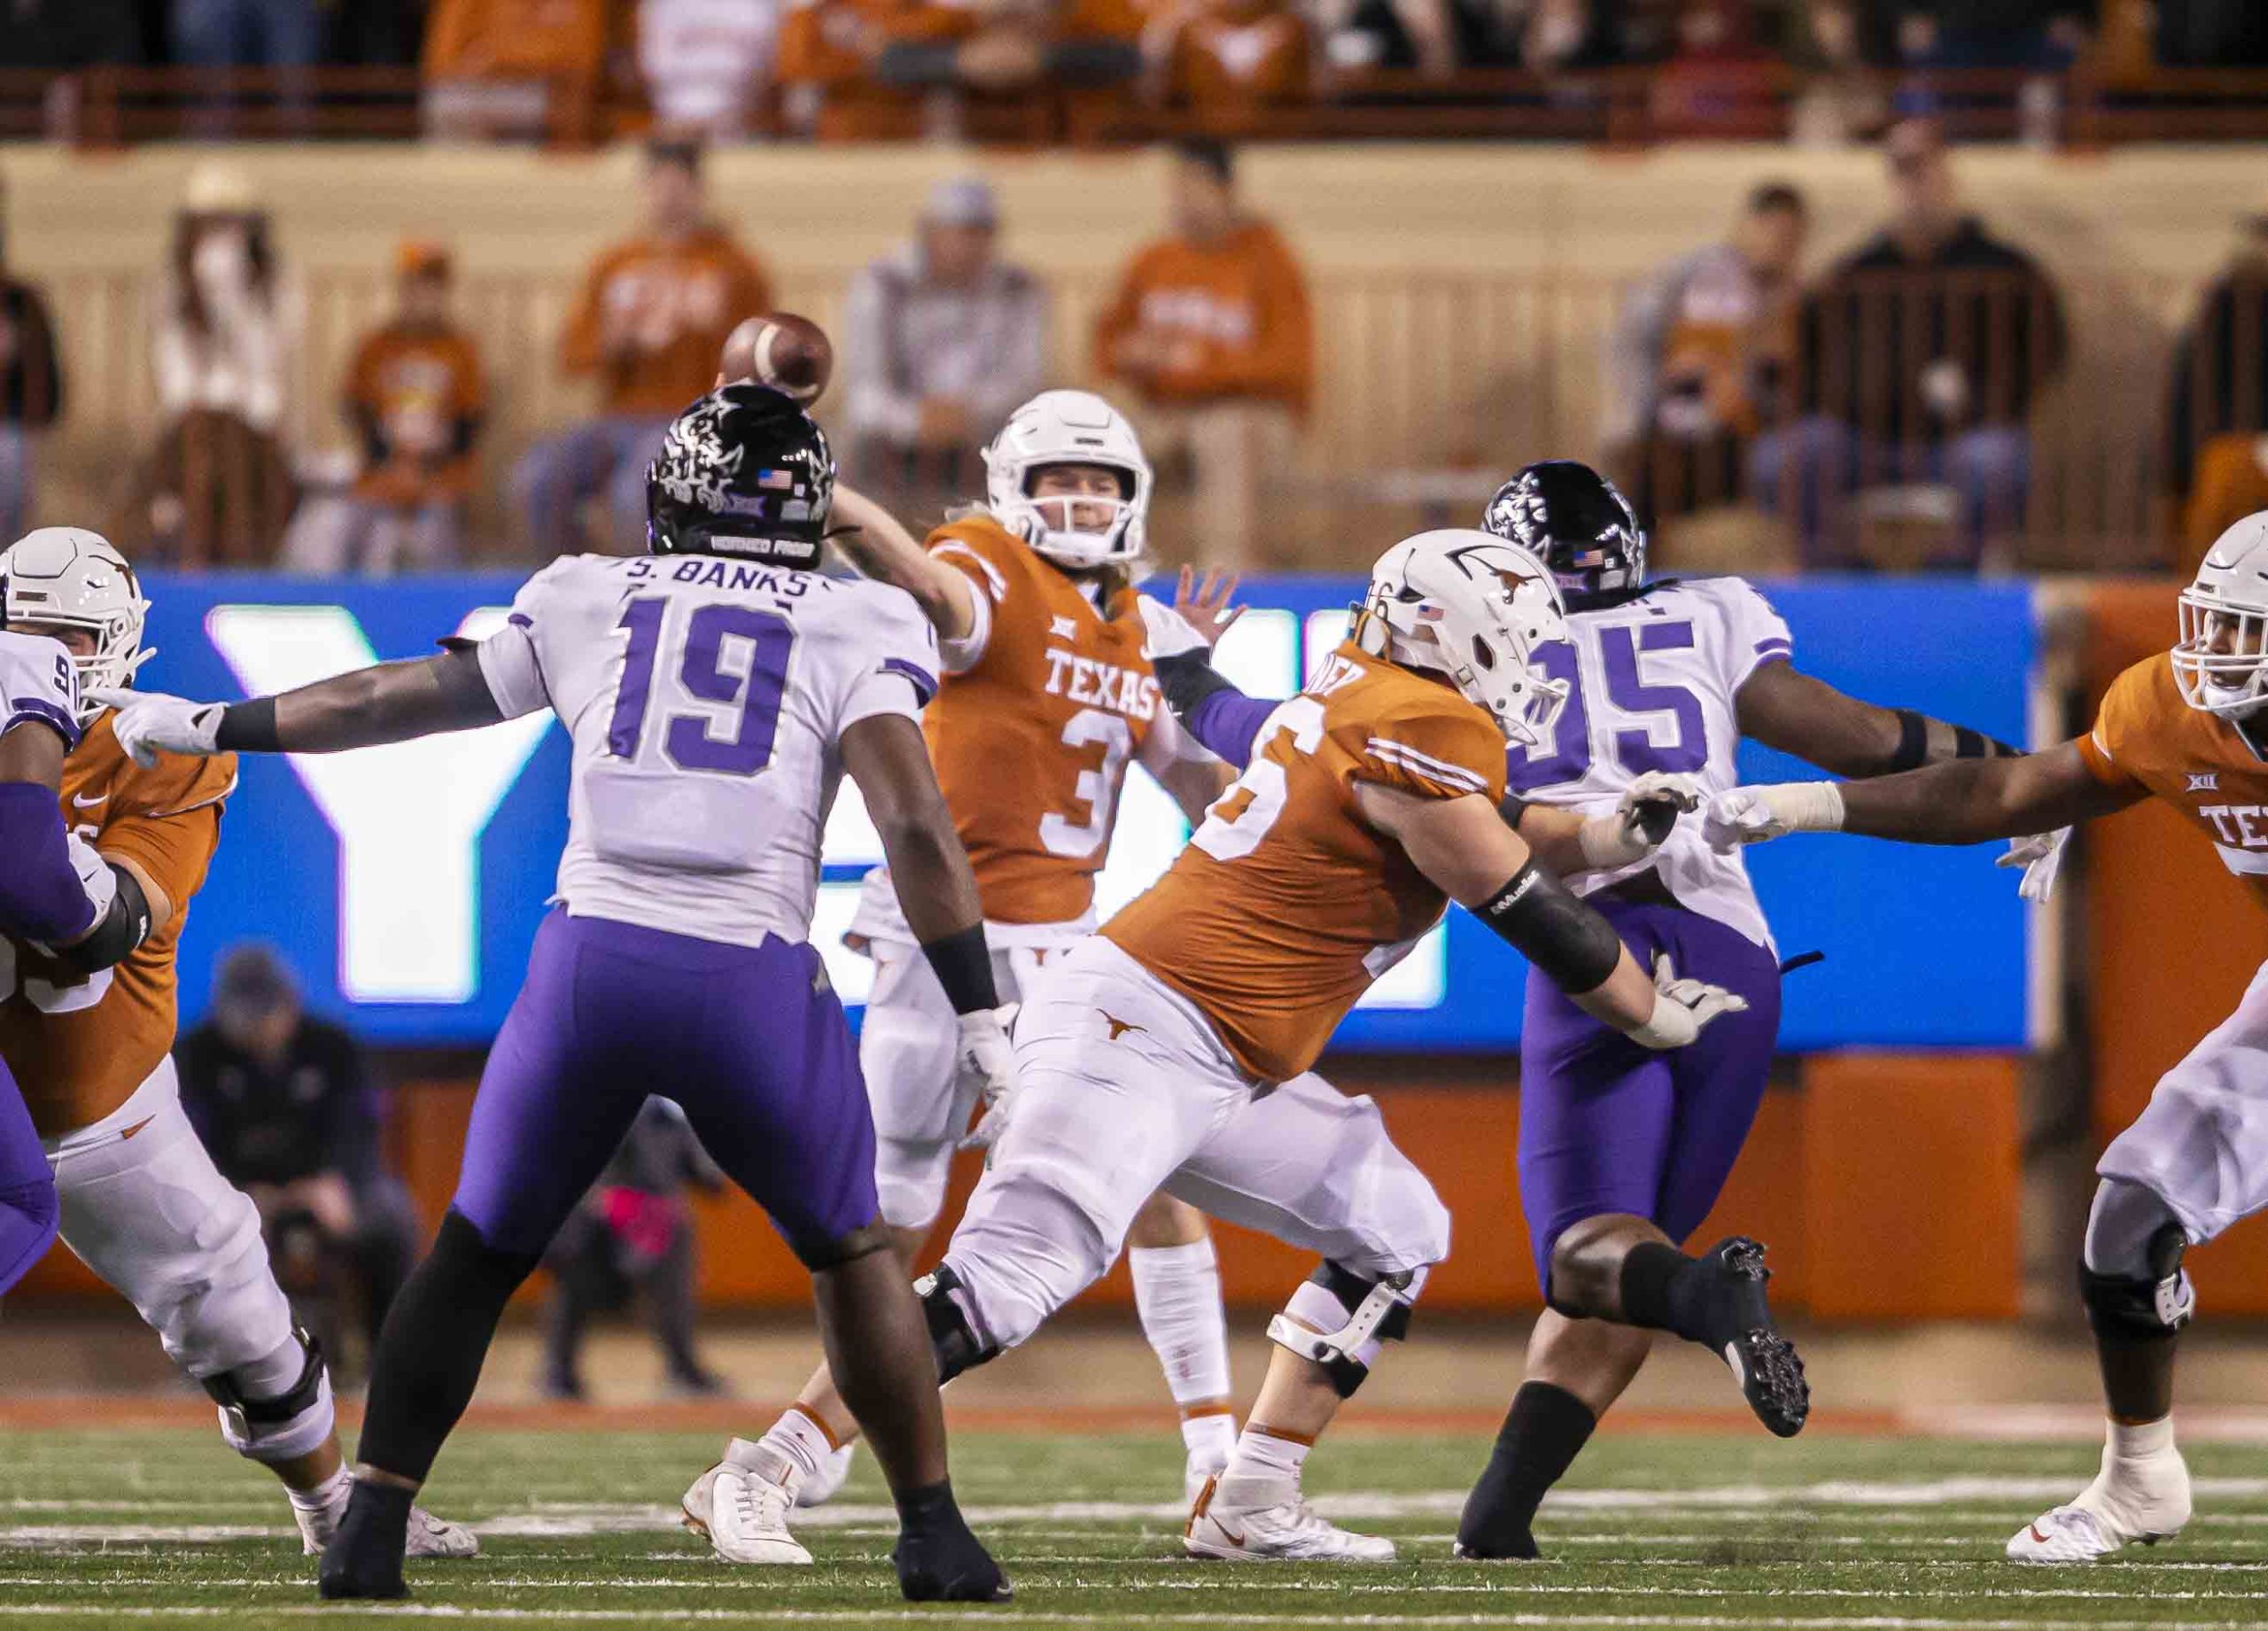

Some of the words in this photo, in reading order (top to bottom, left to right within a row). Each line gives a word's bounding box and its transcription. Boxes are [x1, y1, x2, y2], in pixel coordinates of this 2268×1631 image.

[626, 558, 657, 579] S.
[672, 561, 813, 597] BANKS
[607, 594, 799, 778] 19
[1045, 647, 1161, 721] TEXAS
[1038, 708, 1133, 858] 3
[2198, 804, 2268, 847] TE
